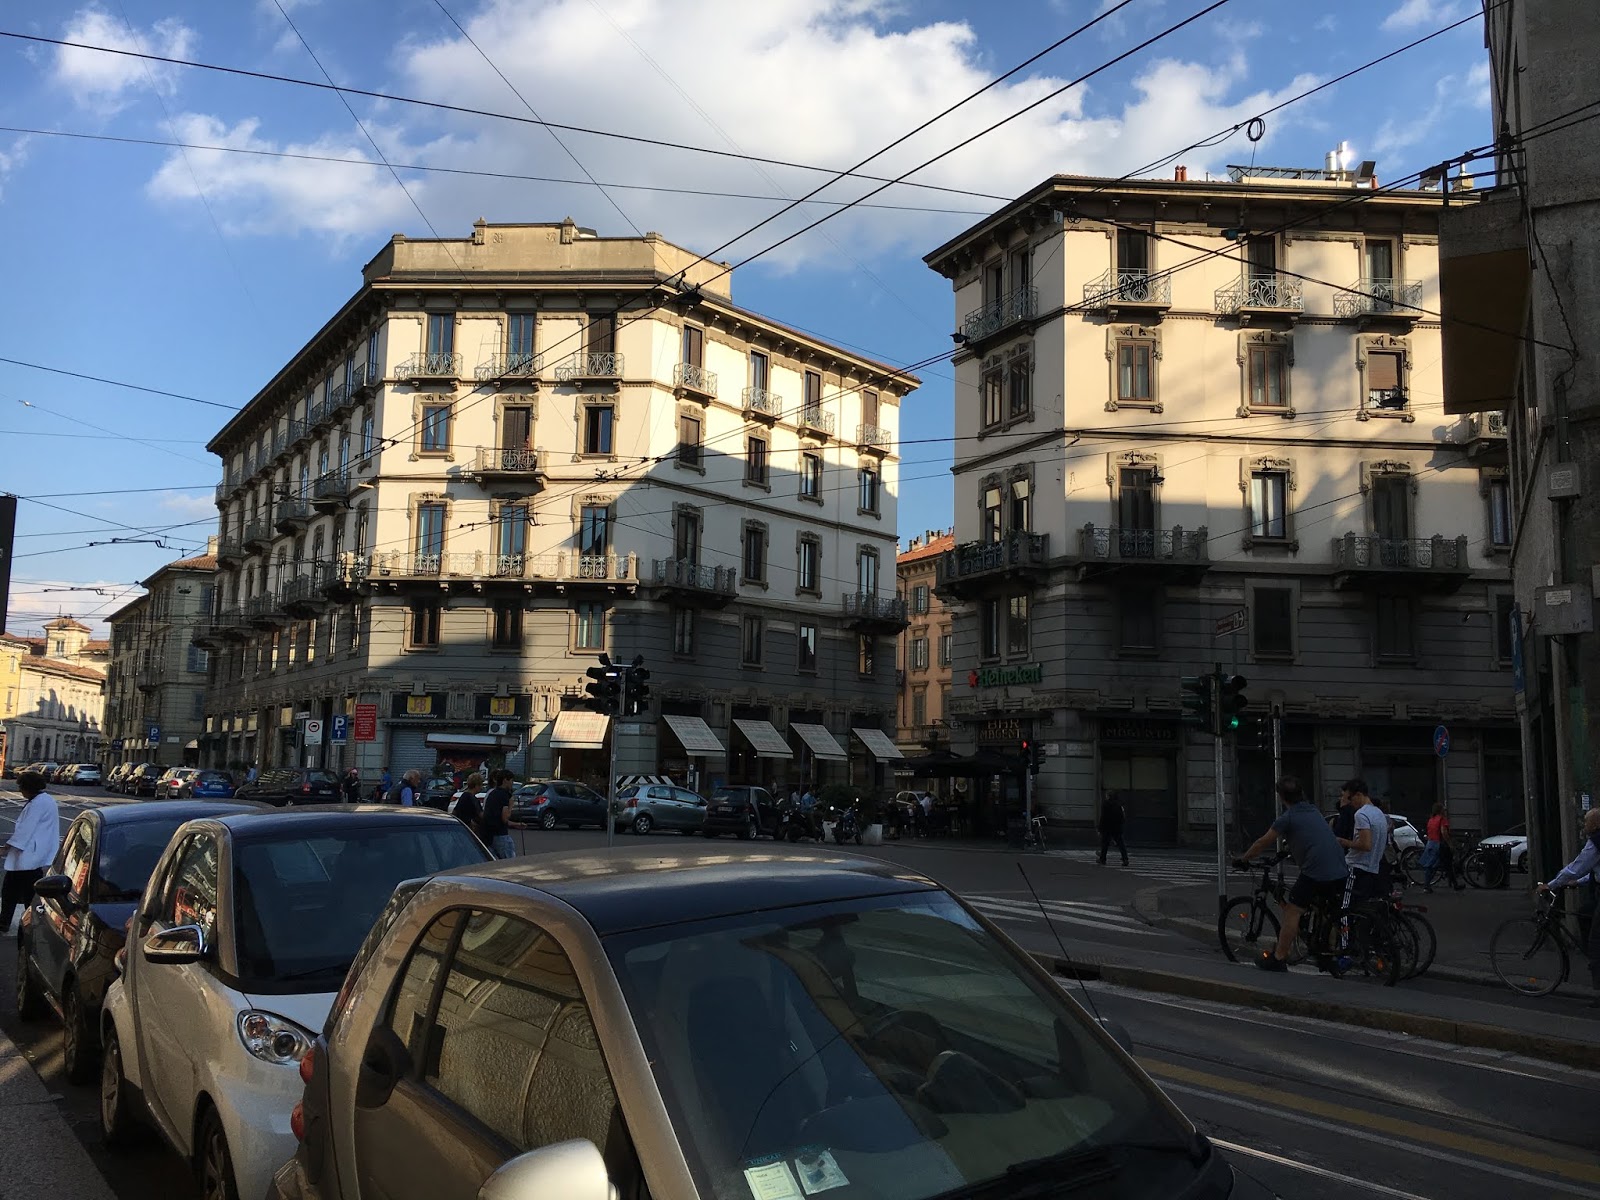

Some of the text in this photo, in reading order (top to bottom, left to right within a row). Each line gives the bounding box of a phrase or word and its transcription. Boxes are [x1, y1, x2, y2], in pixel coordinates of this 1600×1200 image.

[979, 667, 1041, 687] Heineken
[334, 717, 346, 730] P
[987, 719, 1020, 729] BAR
[151, 728, 159, 736] P
